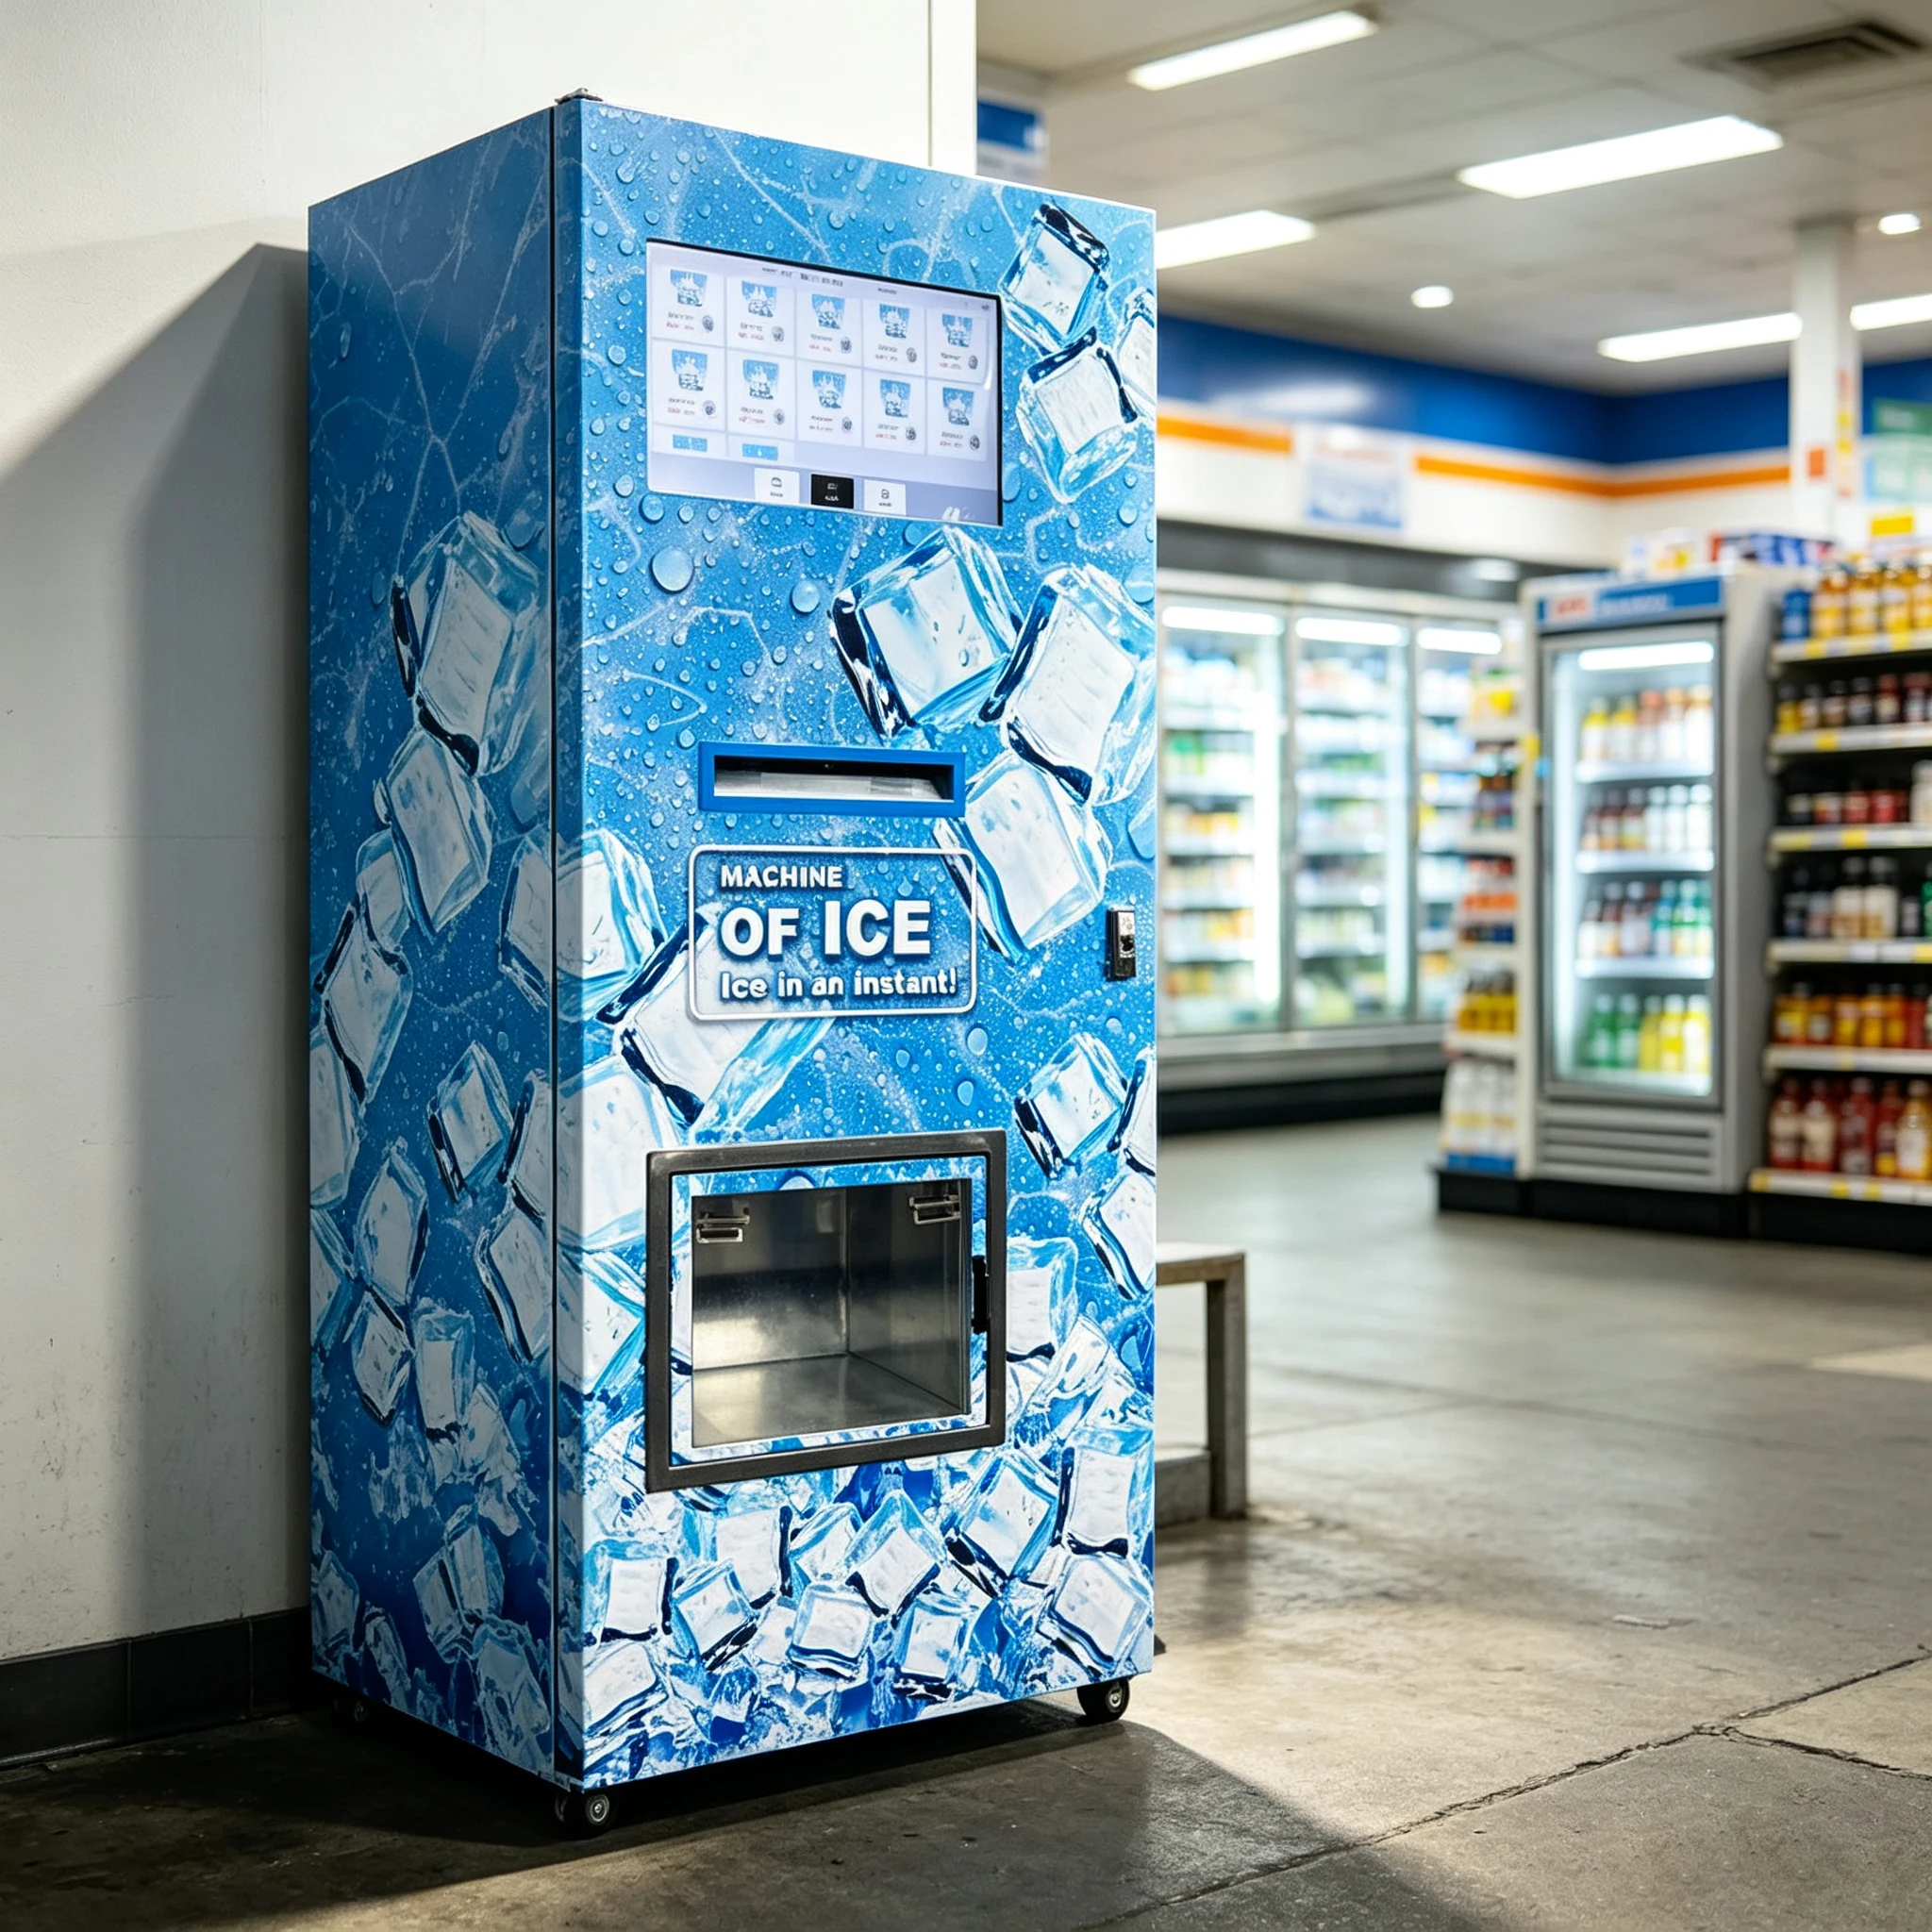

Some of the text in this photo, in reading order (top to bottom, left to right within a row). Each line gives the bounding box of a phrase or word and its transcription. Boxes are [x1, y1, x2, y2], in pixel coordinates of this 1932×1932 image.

[720, 864, 843, 889] MACHINE
[721, 899, 931, 957] OF ICE
[720, 967, 958, 999] Ice in an instant!
